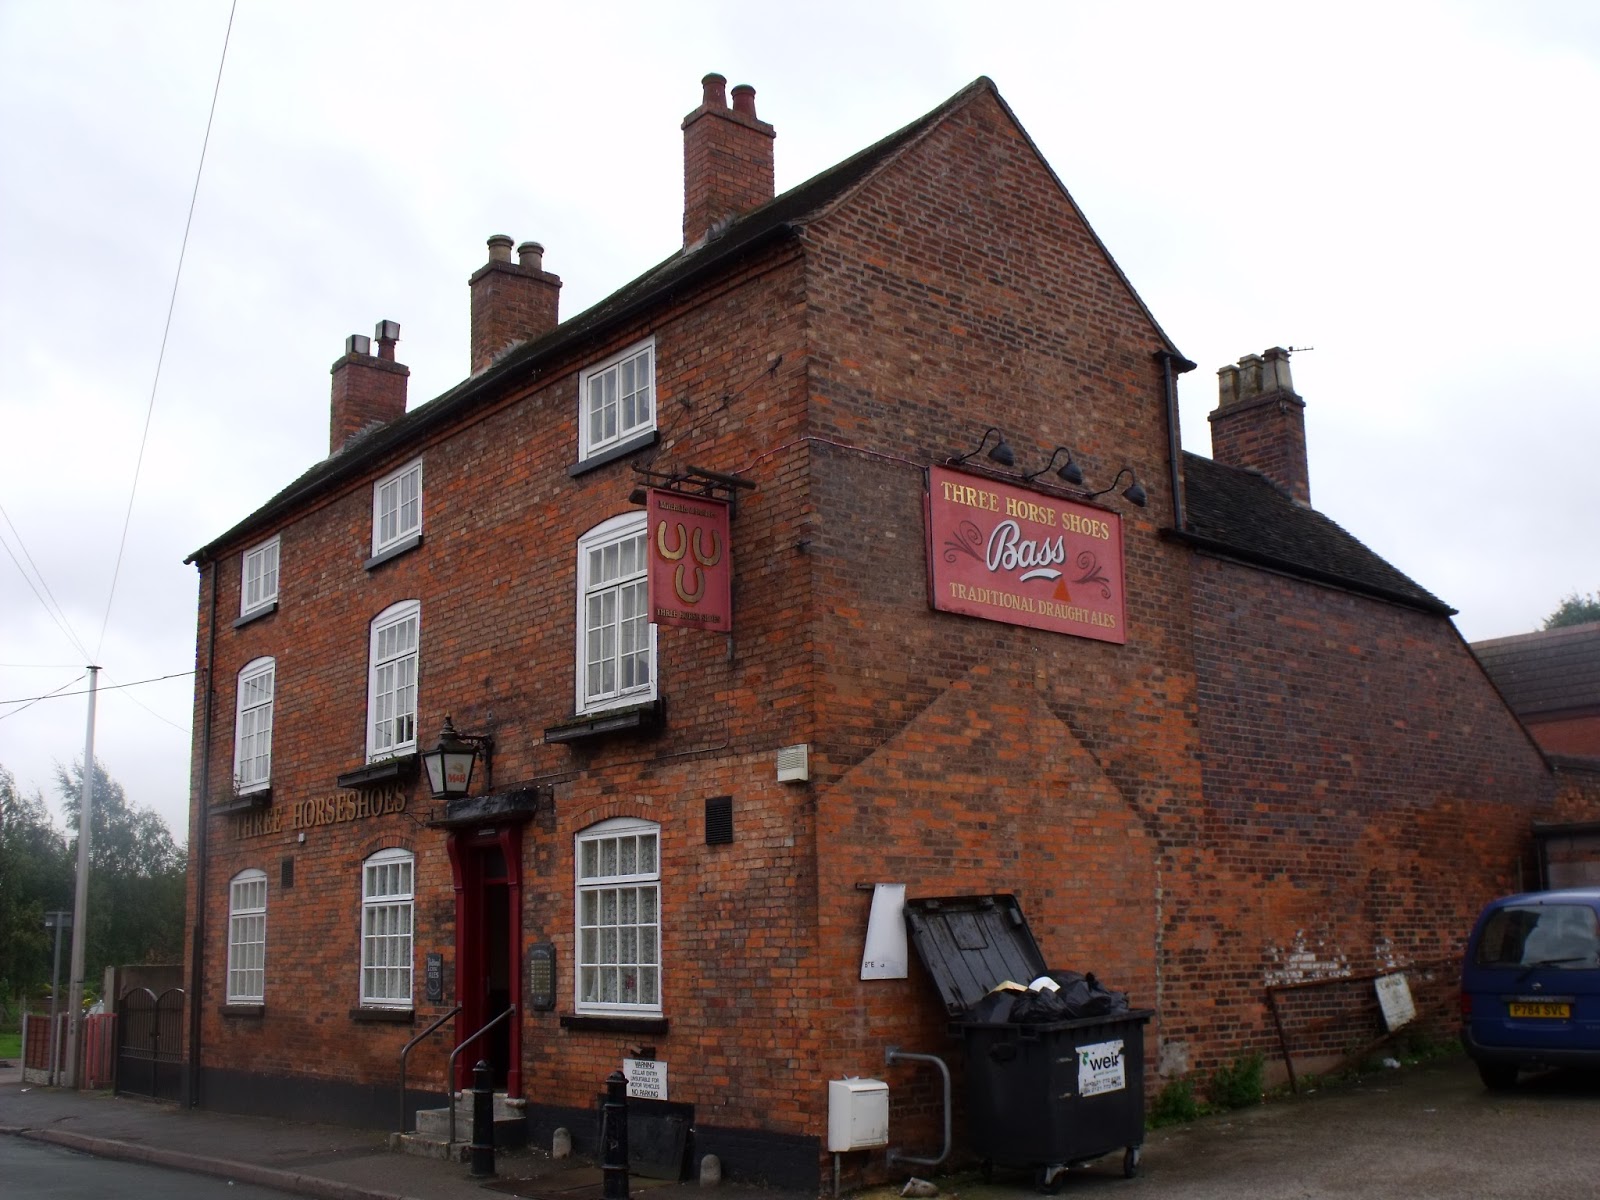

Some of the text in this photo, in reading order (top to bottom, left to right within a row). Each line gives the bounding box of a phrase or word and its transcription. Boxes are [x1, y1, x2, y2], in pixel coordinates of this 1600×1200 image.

[941, 481, 1109, 540] THREE HORSE SHOES
[986, 519, 1066, 572] Bass
[950, 582, 1116, 629] TRADITIONAL DRAUGHT ALES
[235, 806, 282, 840] THREE
